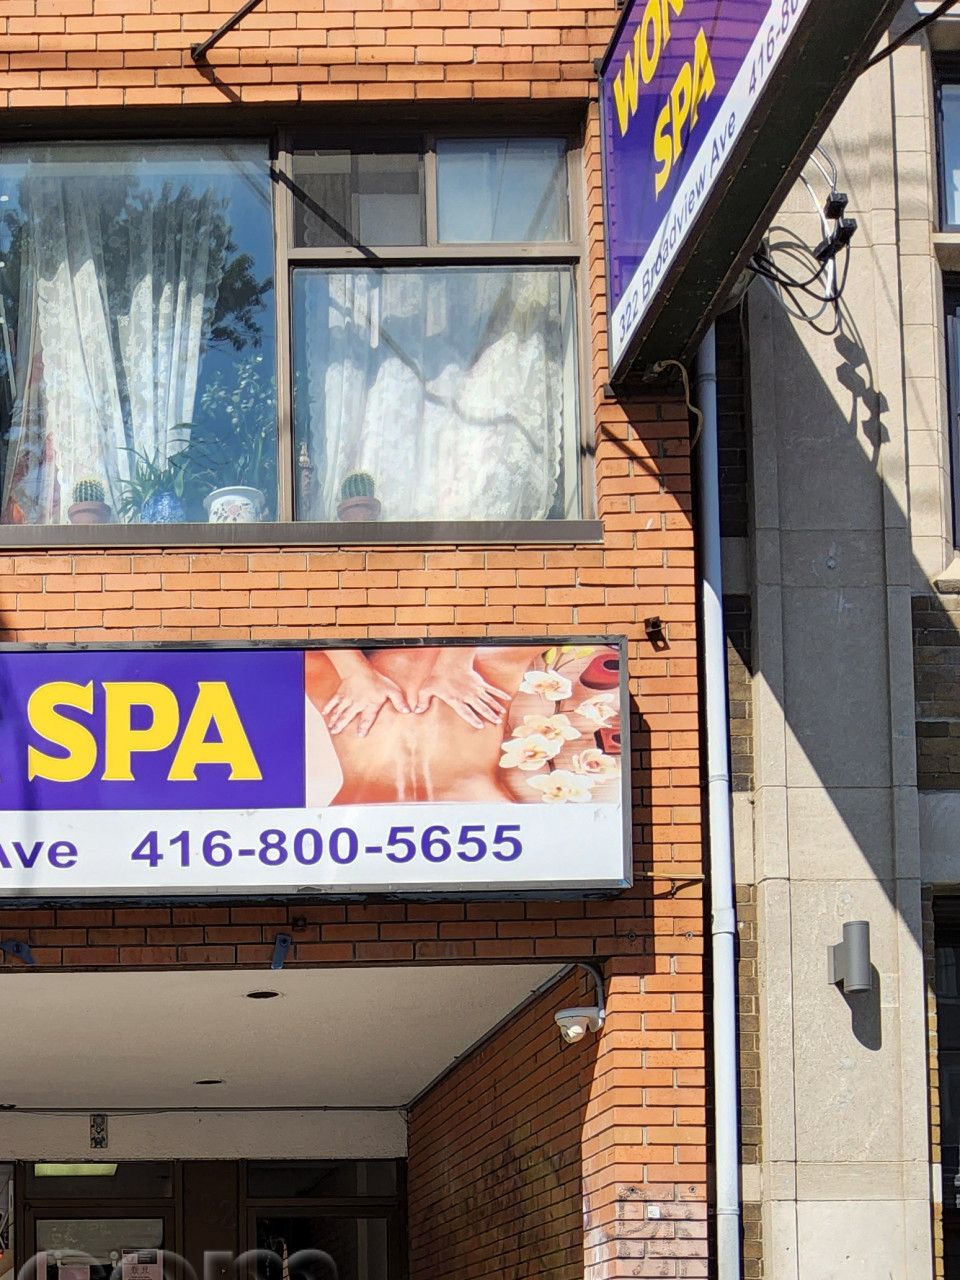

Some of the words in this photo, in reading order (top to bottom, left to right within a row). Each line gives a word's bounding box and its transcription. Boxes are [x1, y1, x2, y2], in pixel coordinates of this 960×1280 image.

[654, 27, 715, 201] SPA
[619, 293, 640, 343] 322
[641, 168, 705, 294] Broadview
[709, 110, 736, 178] Ave
[27, 680, 263, 783] SPA
[131, 823, 525, 870] 416-800-5655
